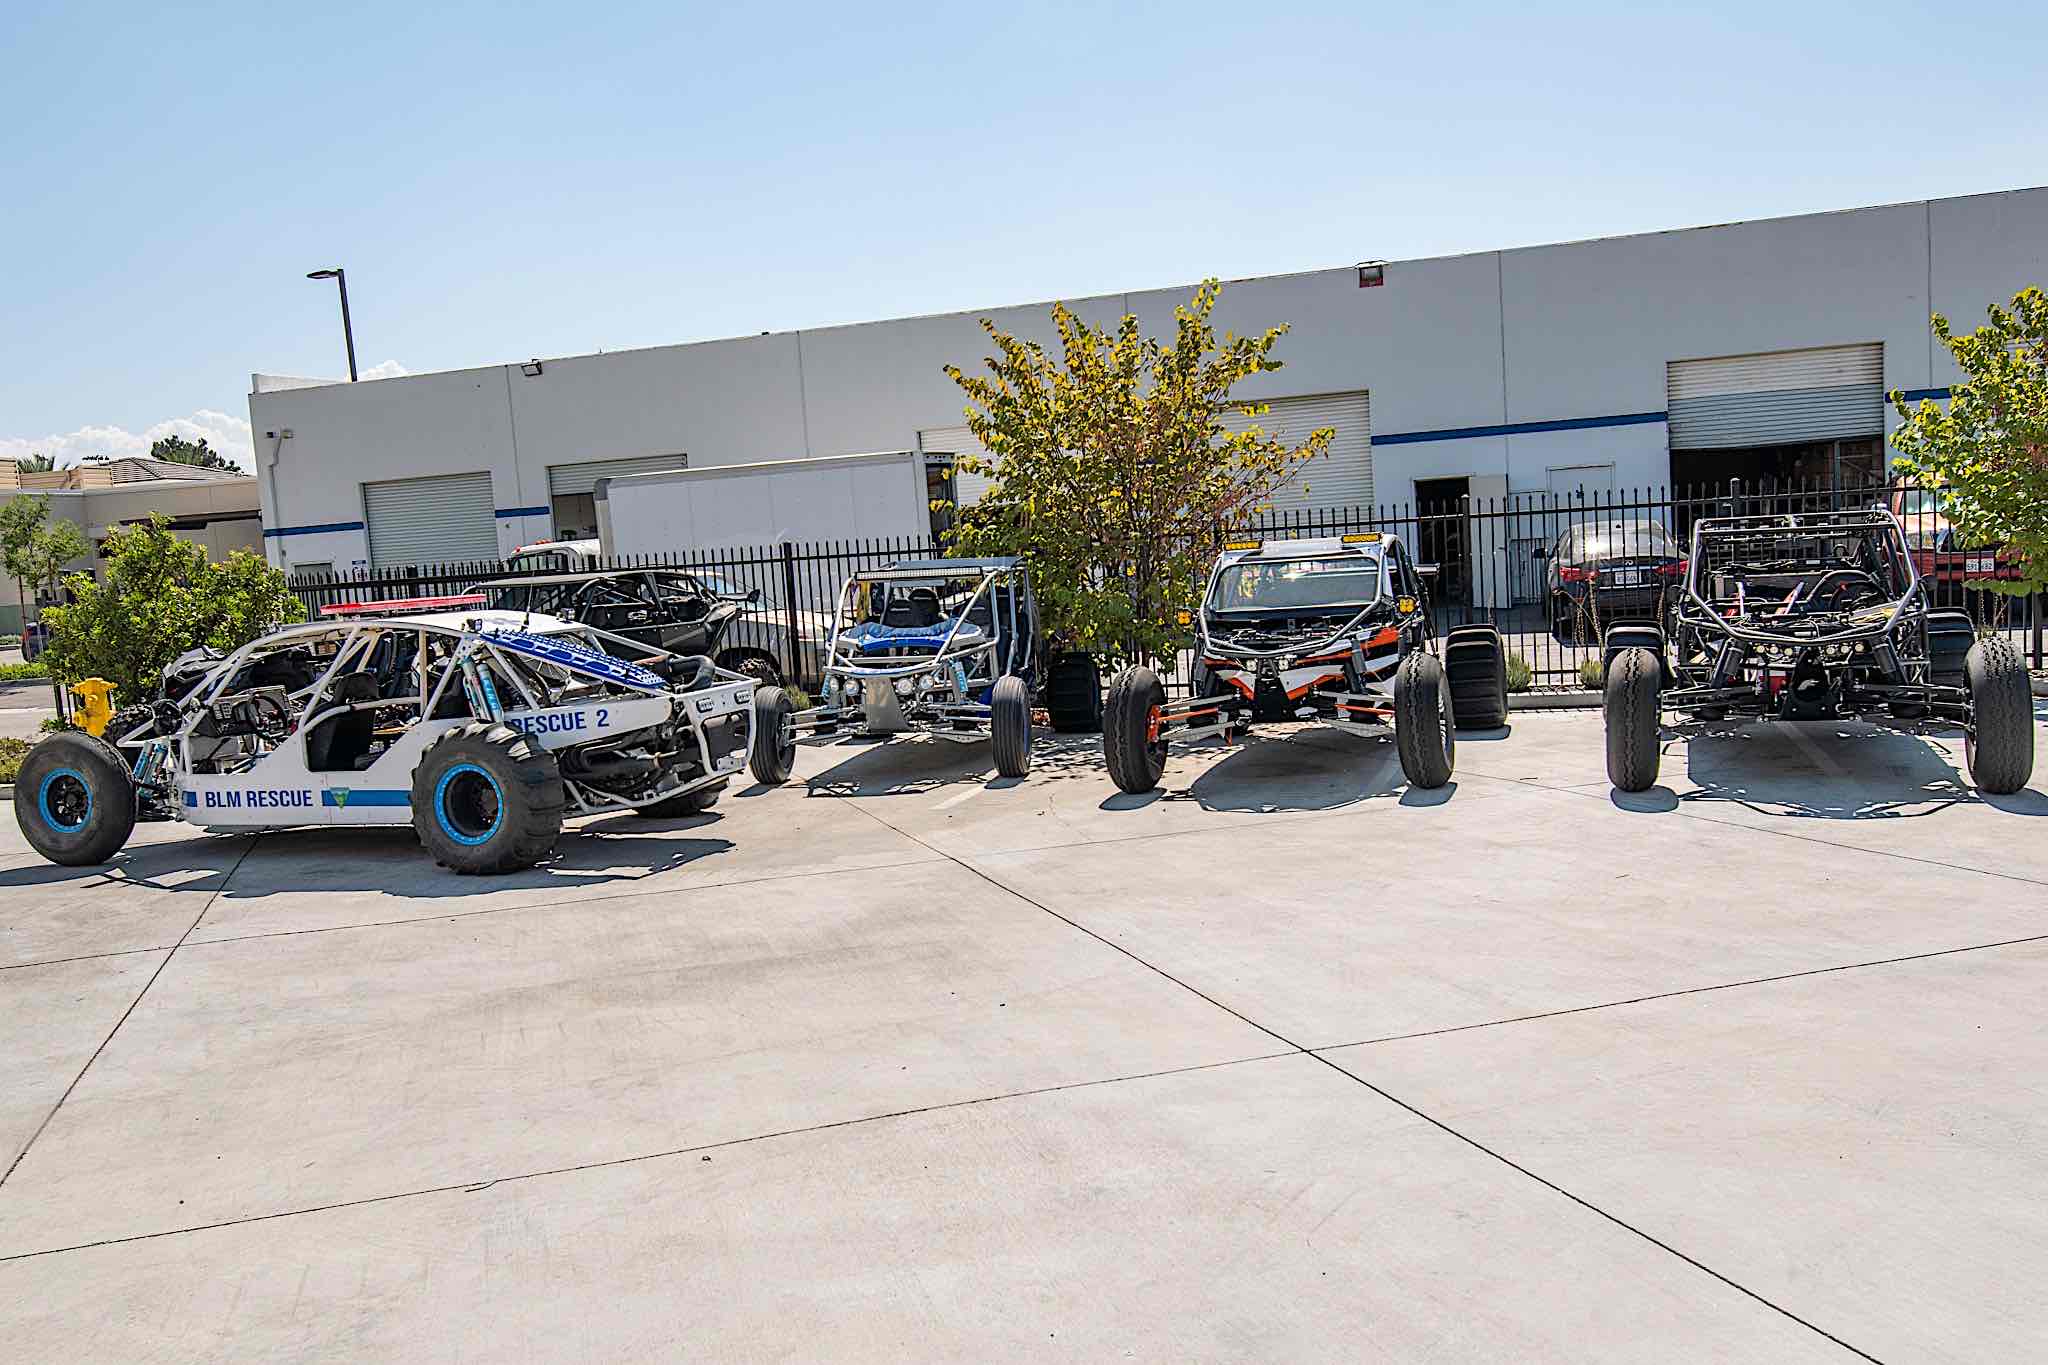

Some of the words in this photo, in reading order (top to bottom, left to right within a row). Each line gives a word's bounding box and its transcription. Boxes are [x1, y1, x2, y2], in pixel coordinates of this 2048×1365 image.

[597, 709, 610, 727] 2
[205, 791, 241, 808] BLM
[246, 790, 313, 807] RESCUE
